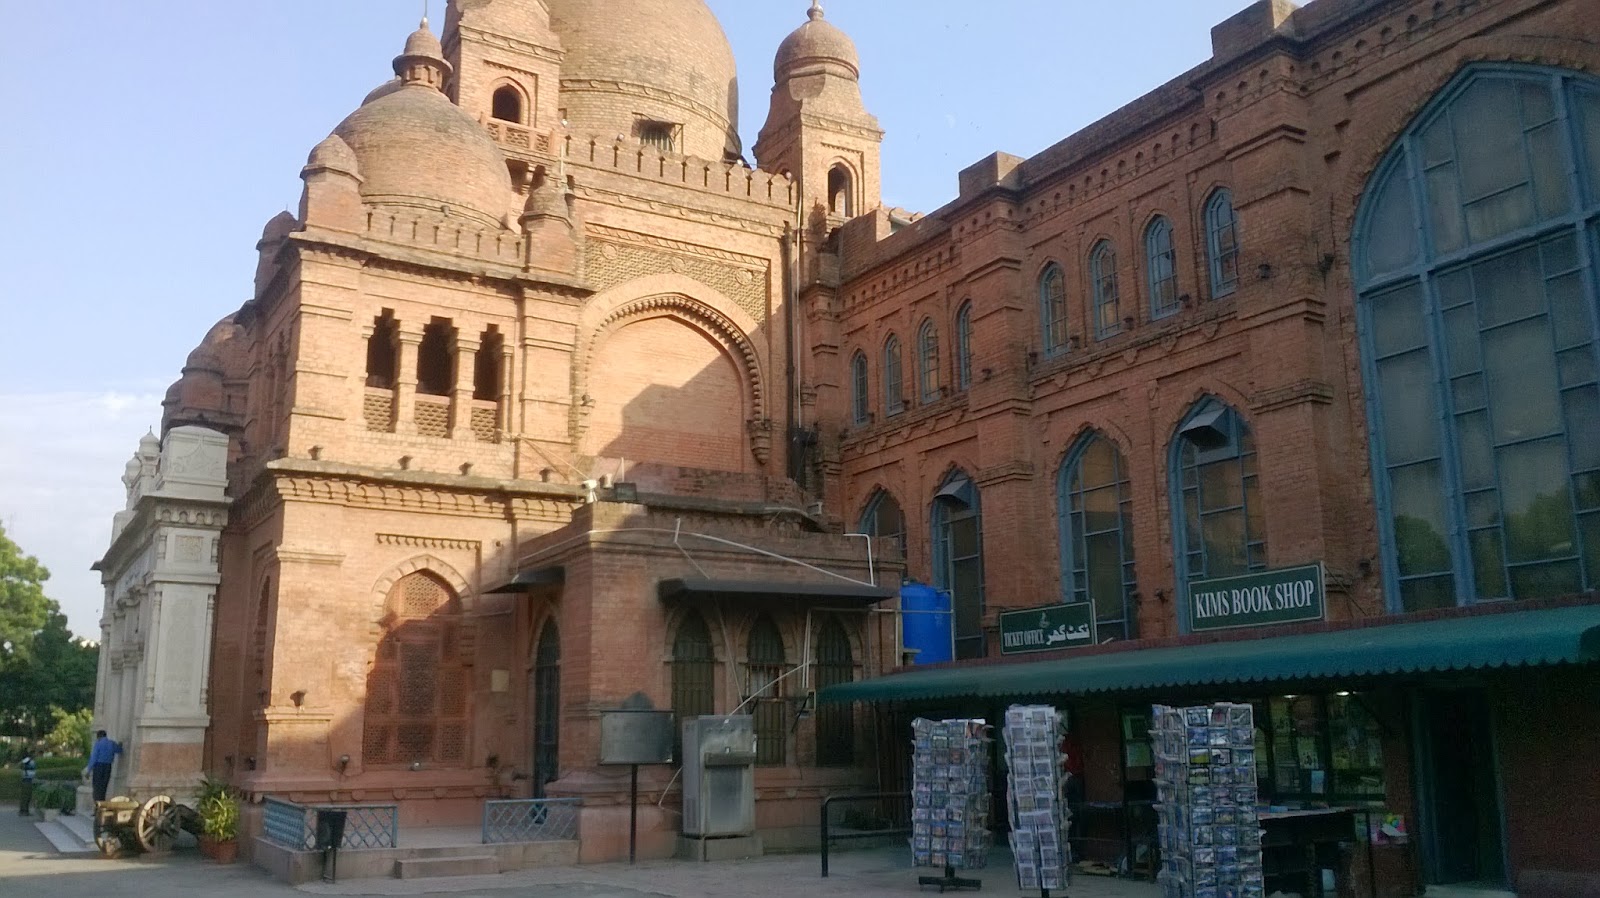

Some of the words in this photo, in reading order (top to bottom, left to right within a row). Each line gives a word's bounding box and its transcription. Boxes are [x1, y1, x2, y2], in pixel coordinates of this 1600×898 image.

[1195, 590, 1230, 618] KIMS
[1231, 585, 1273, 614] BOOK
[1274, 580, 1314, 610] SHOP
[1004, 631, 1023, 647] TICKET
[1024, 629, 1044, 645] OFFICE
